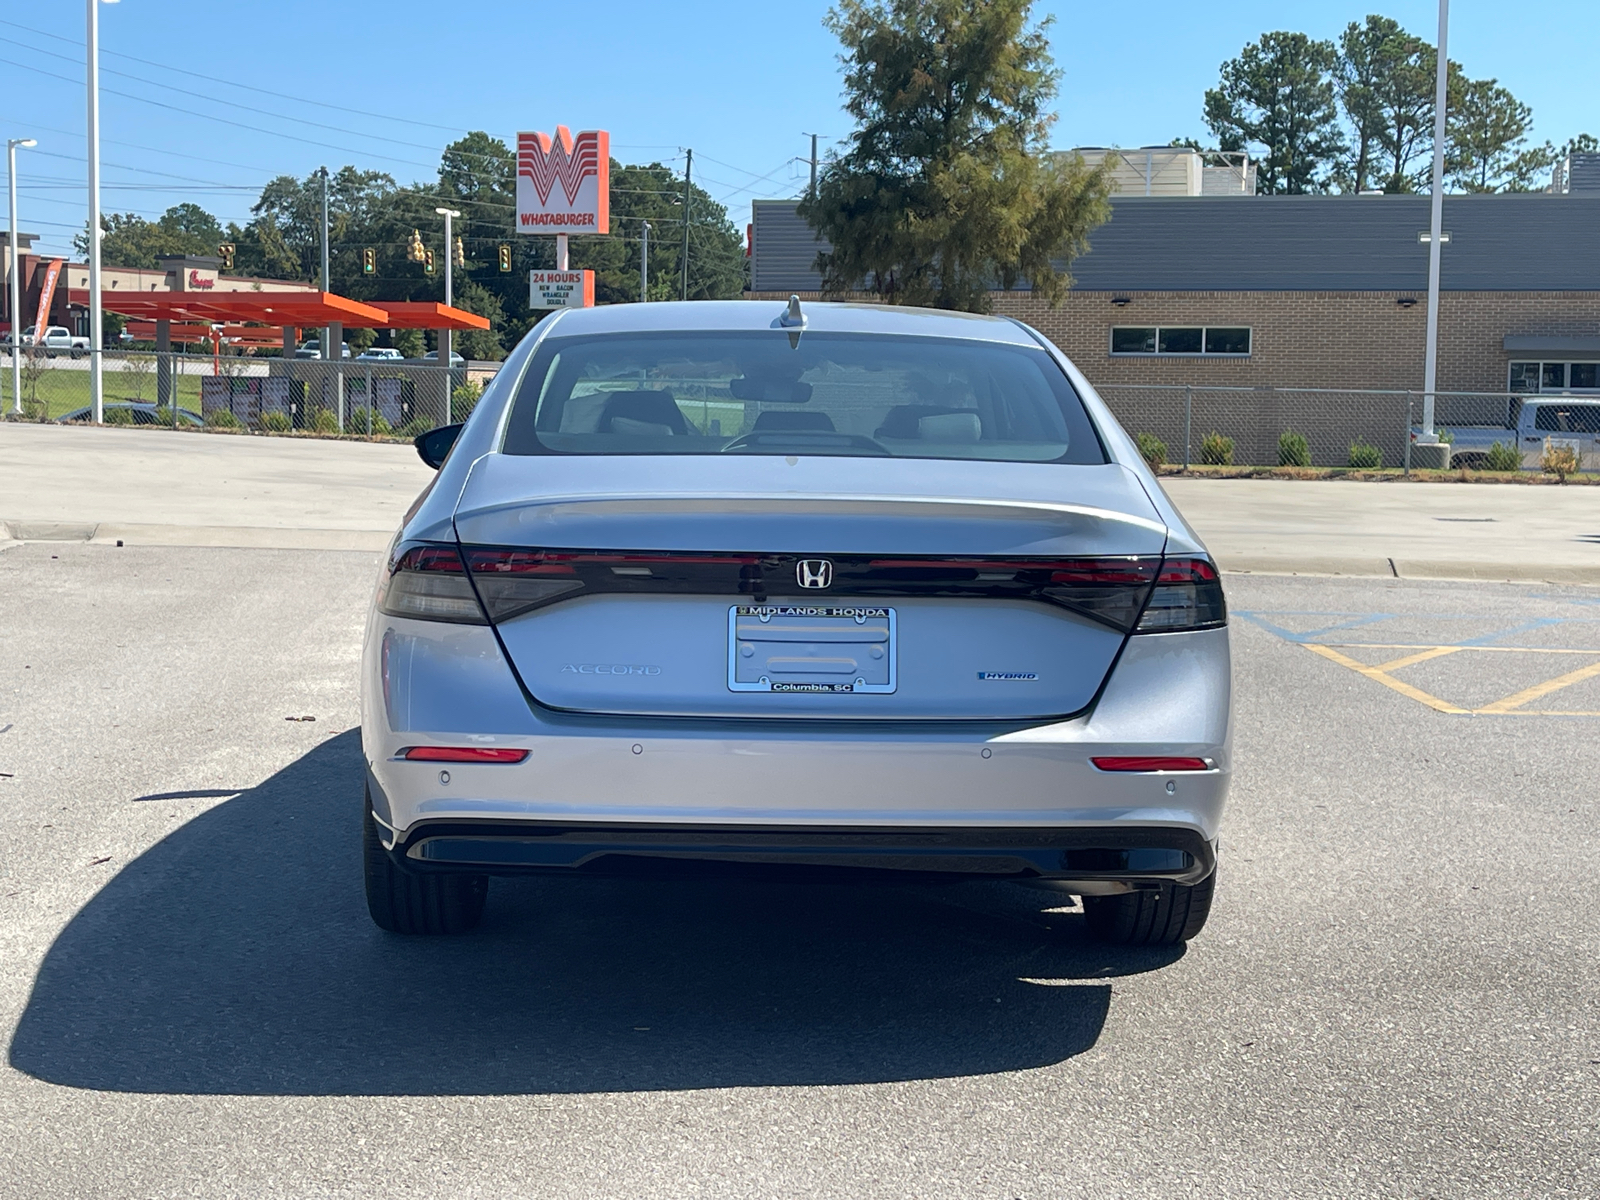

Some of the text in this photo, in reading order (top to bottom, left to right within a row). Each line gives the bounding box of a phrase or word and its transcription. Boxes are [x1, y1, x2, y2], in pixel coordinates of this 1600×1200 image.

[520, 213, 595, 226] WHATABURGER
[533, 273, 581, 283] 24 HOURS
[749, 606, 887, 617] MIDLANDS HONDA
[560, 663, 662, 676] ACCORD
[985, 672, 1037, 680] HYBRID
[773, 683, 852, 692] Columbia, SC
